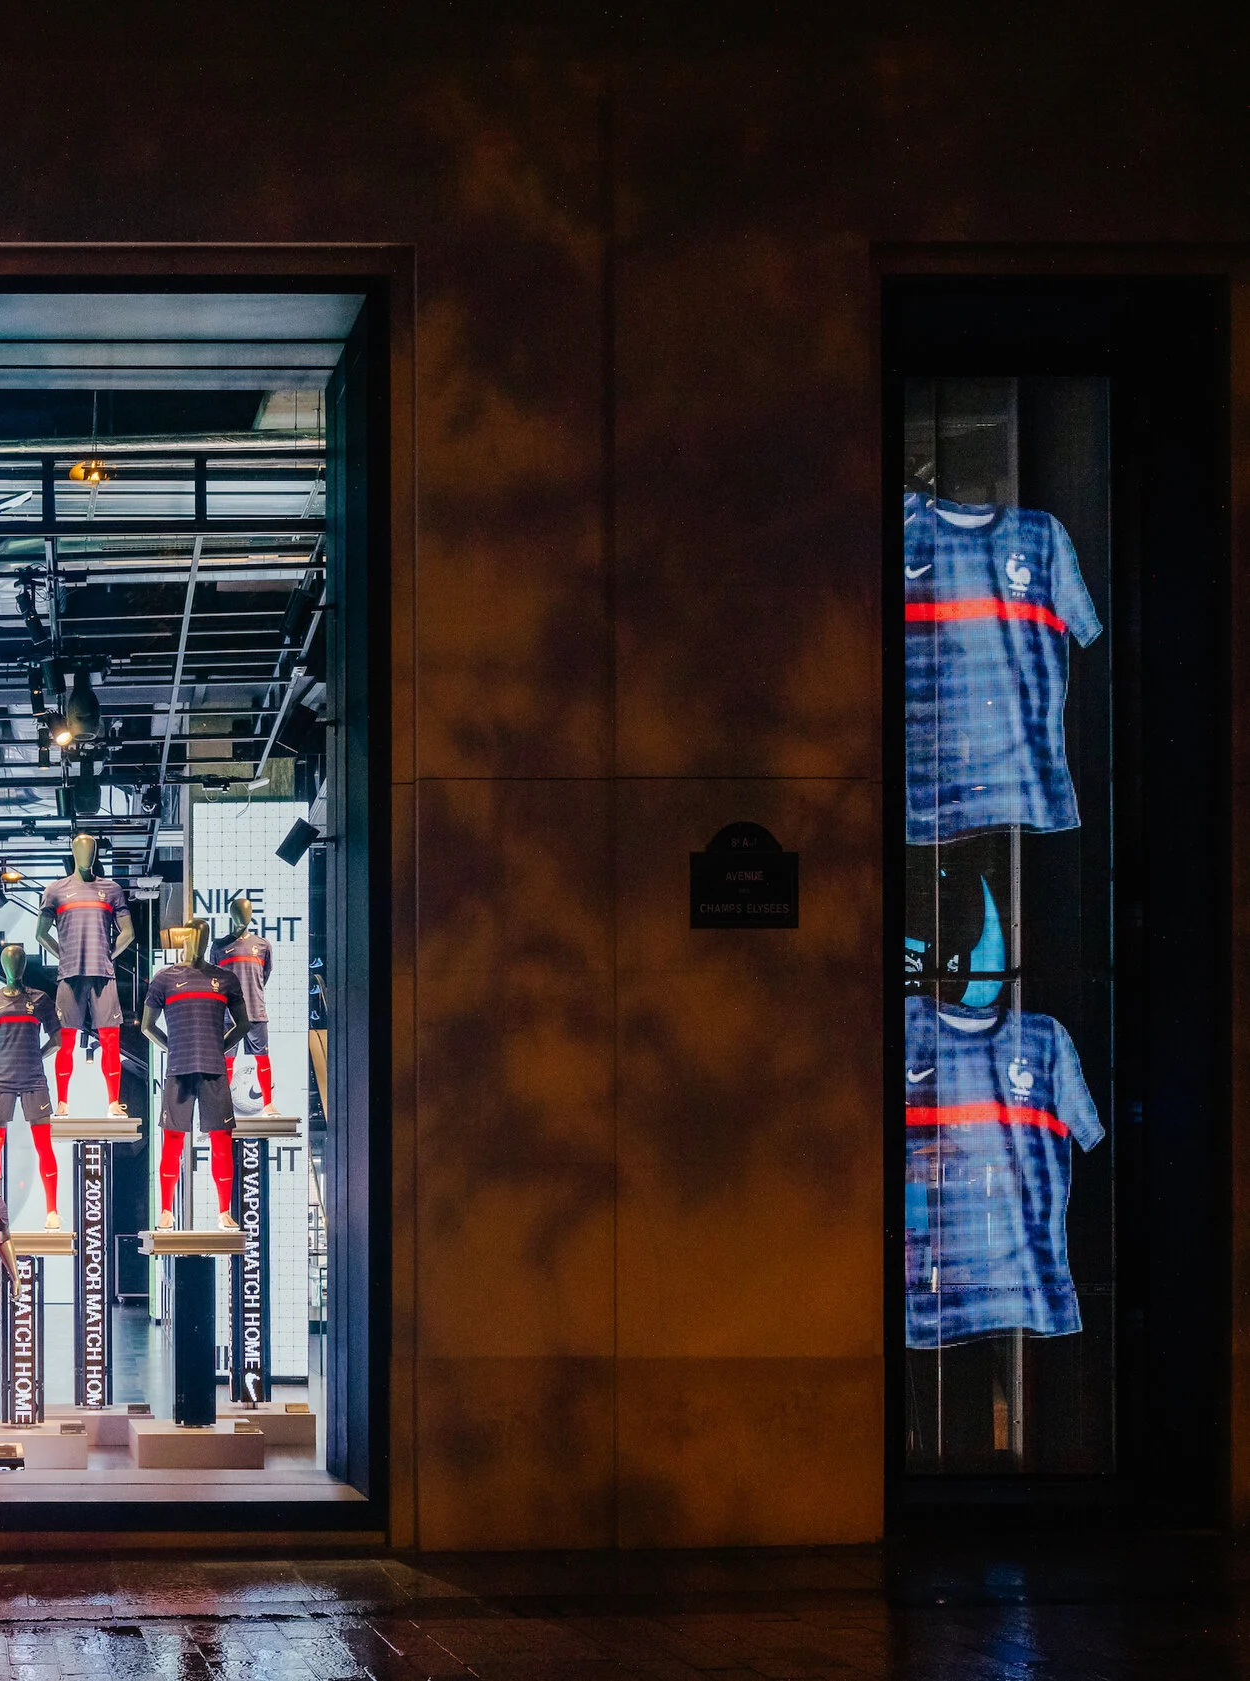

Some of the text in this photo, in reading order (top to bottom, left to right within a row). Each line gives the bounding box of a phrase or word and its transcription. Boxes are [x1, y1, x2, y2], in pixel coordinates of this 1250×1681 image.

[725, 870, 764, 881] AVENUE
[193, 888, 264, 913] NIKE
[699, 903, 742, 914] CHAMPS
[85, 1144, 101, 1176] FFF
[85, 1180, 102, 1222] 2020
[85, 1224, 102, 1291] VAPOR
[14, 1284, 32, 1357] MATCH
[86, 1294, 102, 1361] MATCH
[244, 1314, 261, 1370] HOME
[15, 1362, 32, 1423] HOME
